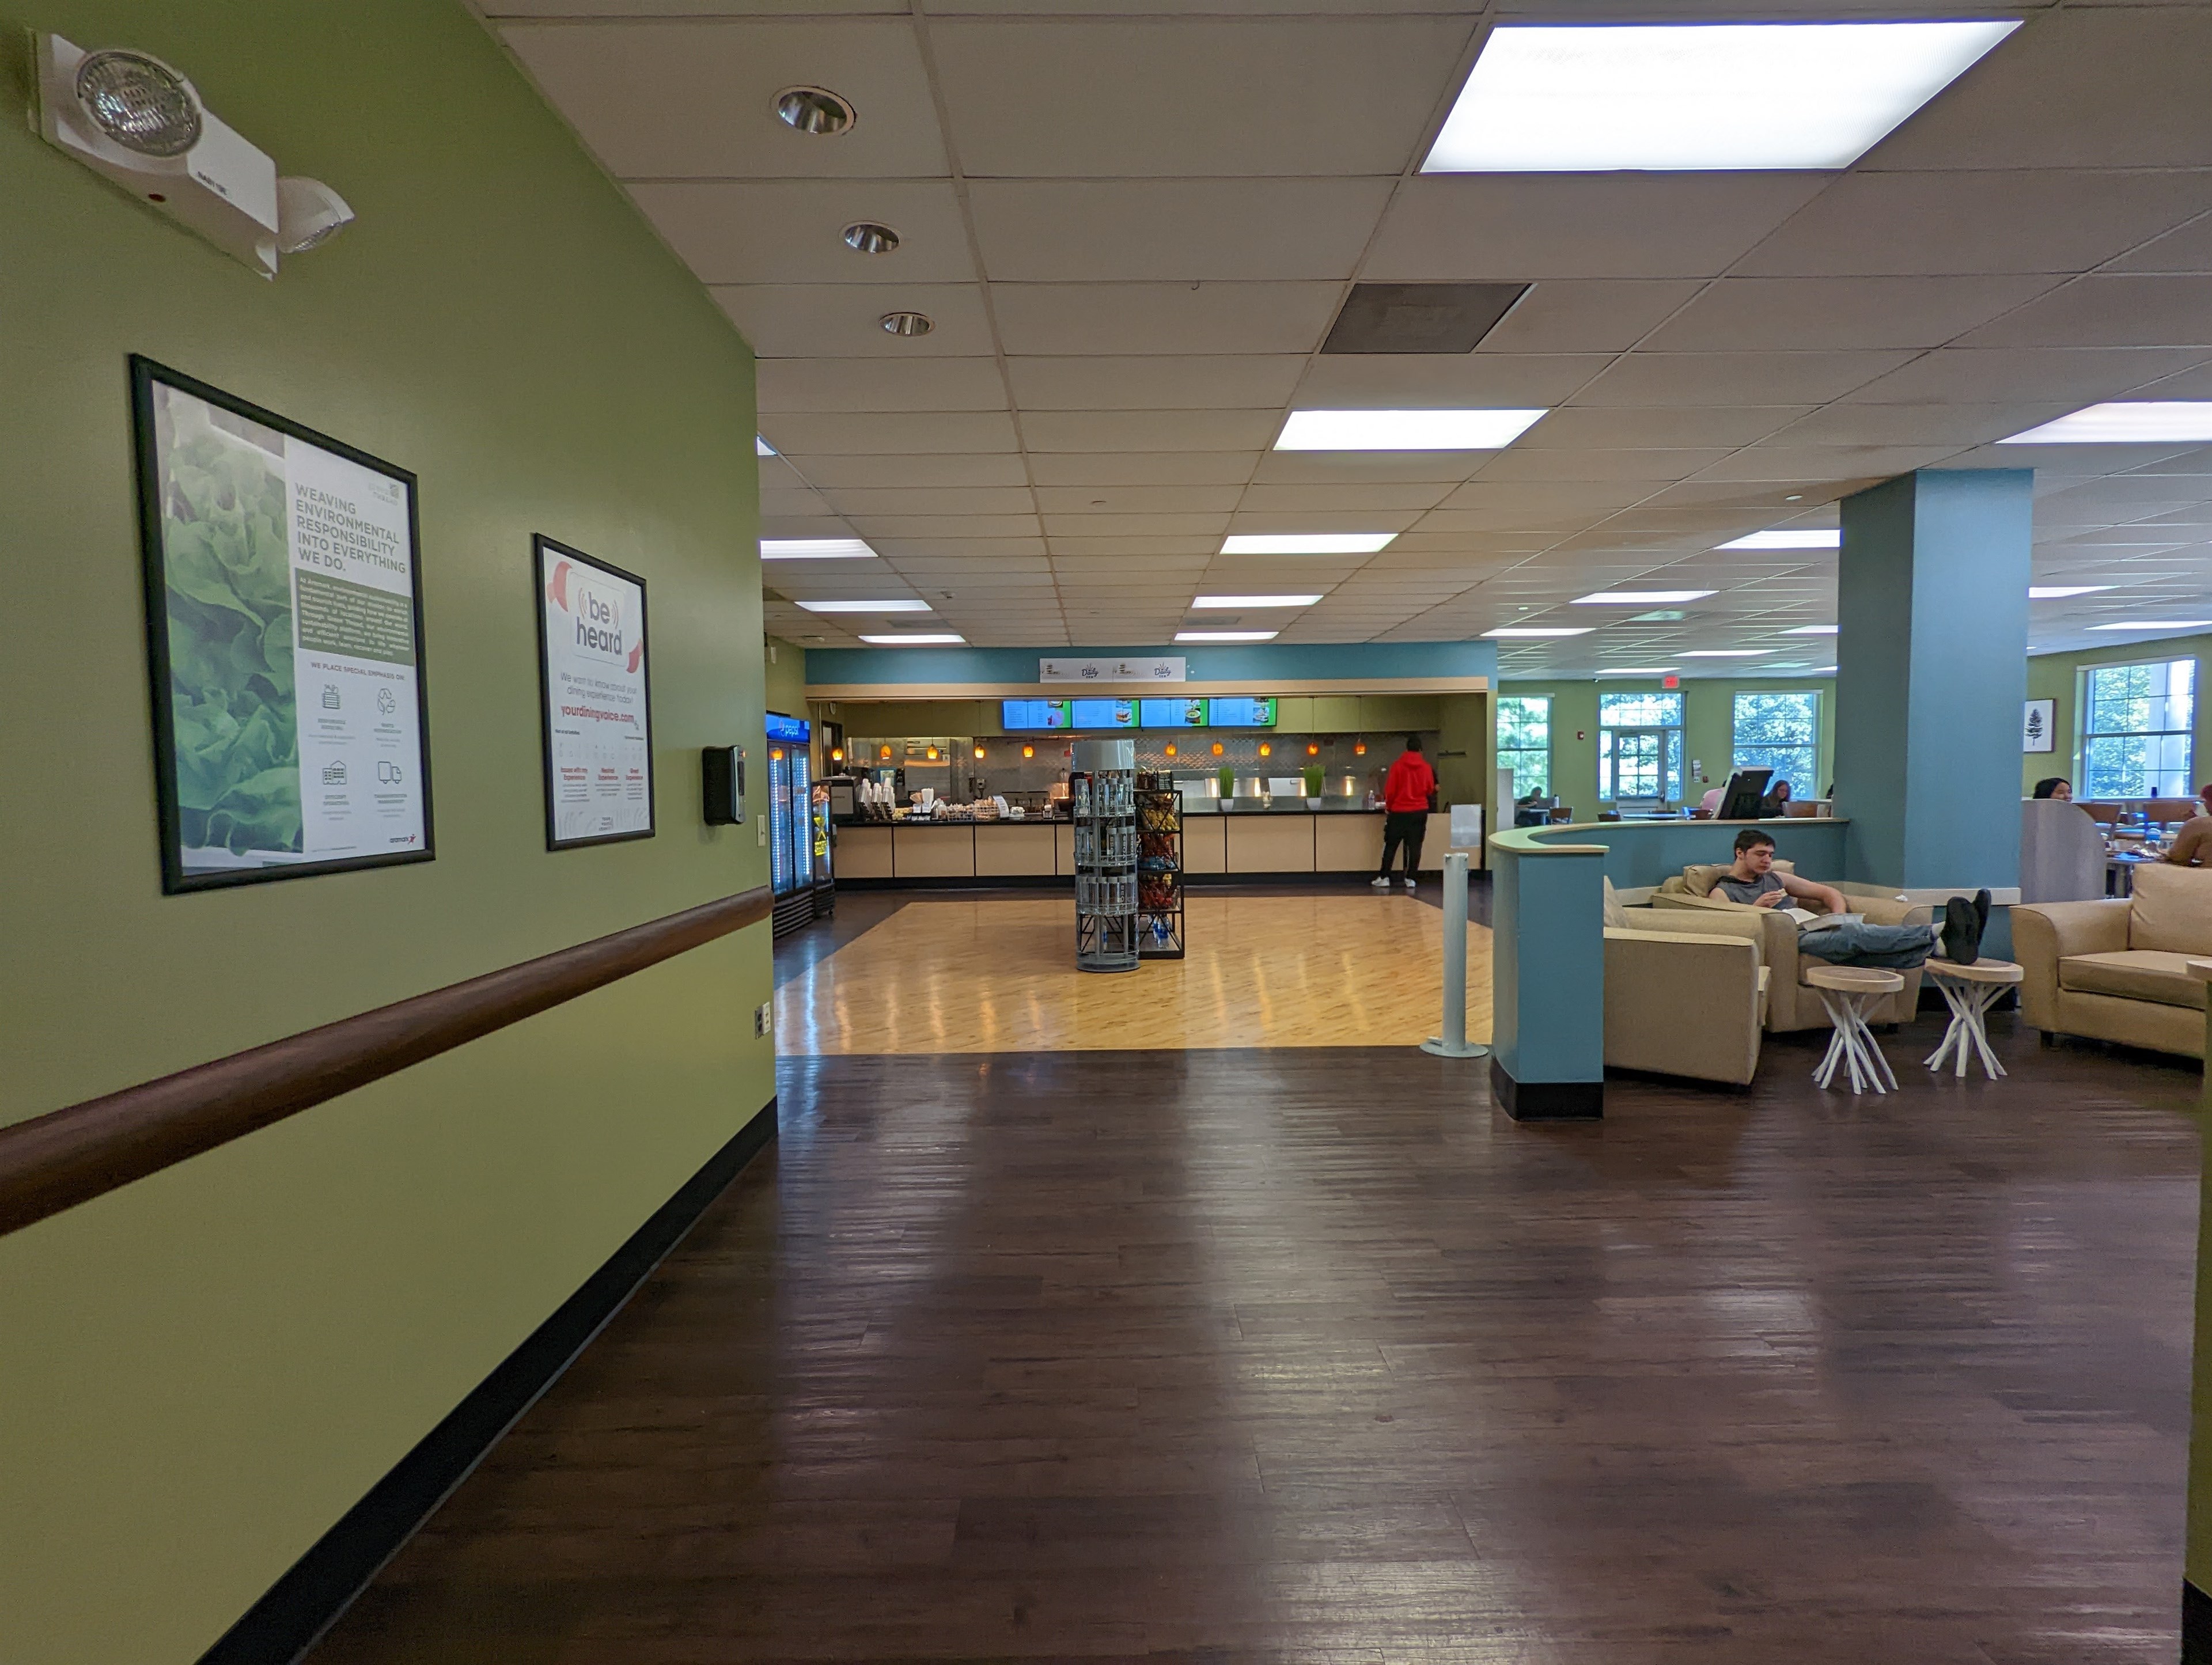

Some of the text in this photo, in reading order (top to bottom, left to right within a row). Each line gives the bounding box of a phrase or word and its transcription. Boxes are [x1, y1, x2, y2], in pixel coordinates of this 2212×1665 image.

[295, 483, 356, 514] WEAVING
[296, 499, 399, 544] ENVIRONMENTAL
[297, 515, 395, 556] RESPONSIBILITY
[298, 532, 406, 573] INTO EVERYTHING
[298, 548, 346, 571] WE DO.
[588, 591, 610, 624] be
[577, 616, 622, 655] heard
[323, 663, 342, 672] PLACE
[343, 666, 366, 675] SPECIAL
[560, 672, 571, 682] We
[1082, 668, 1099, 677] Daily
[1154, 667, 1172, 676] Daily
[560, 706, 634, 723] yourdiningvoice.com
[785, 725, 799, 738] pepsi
